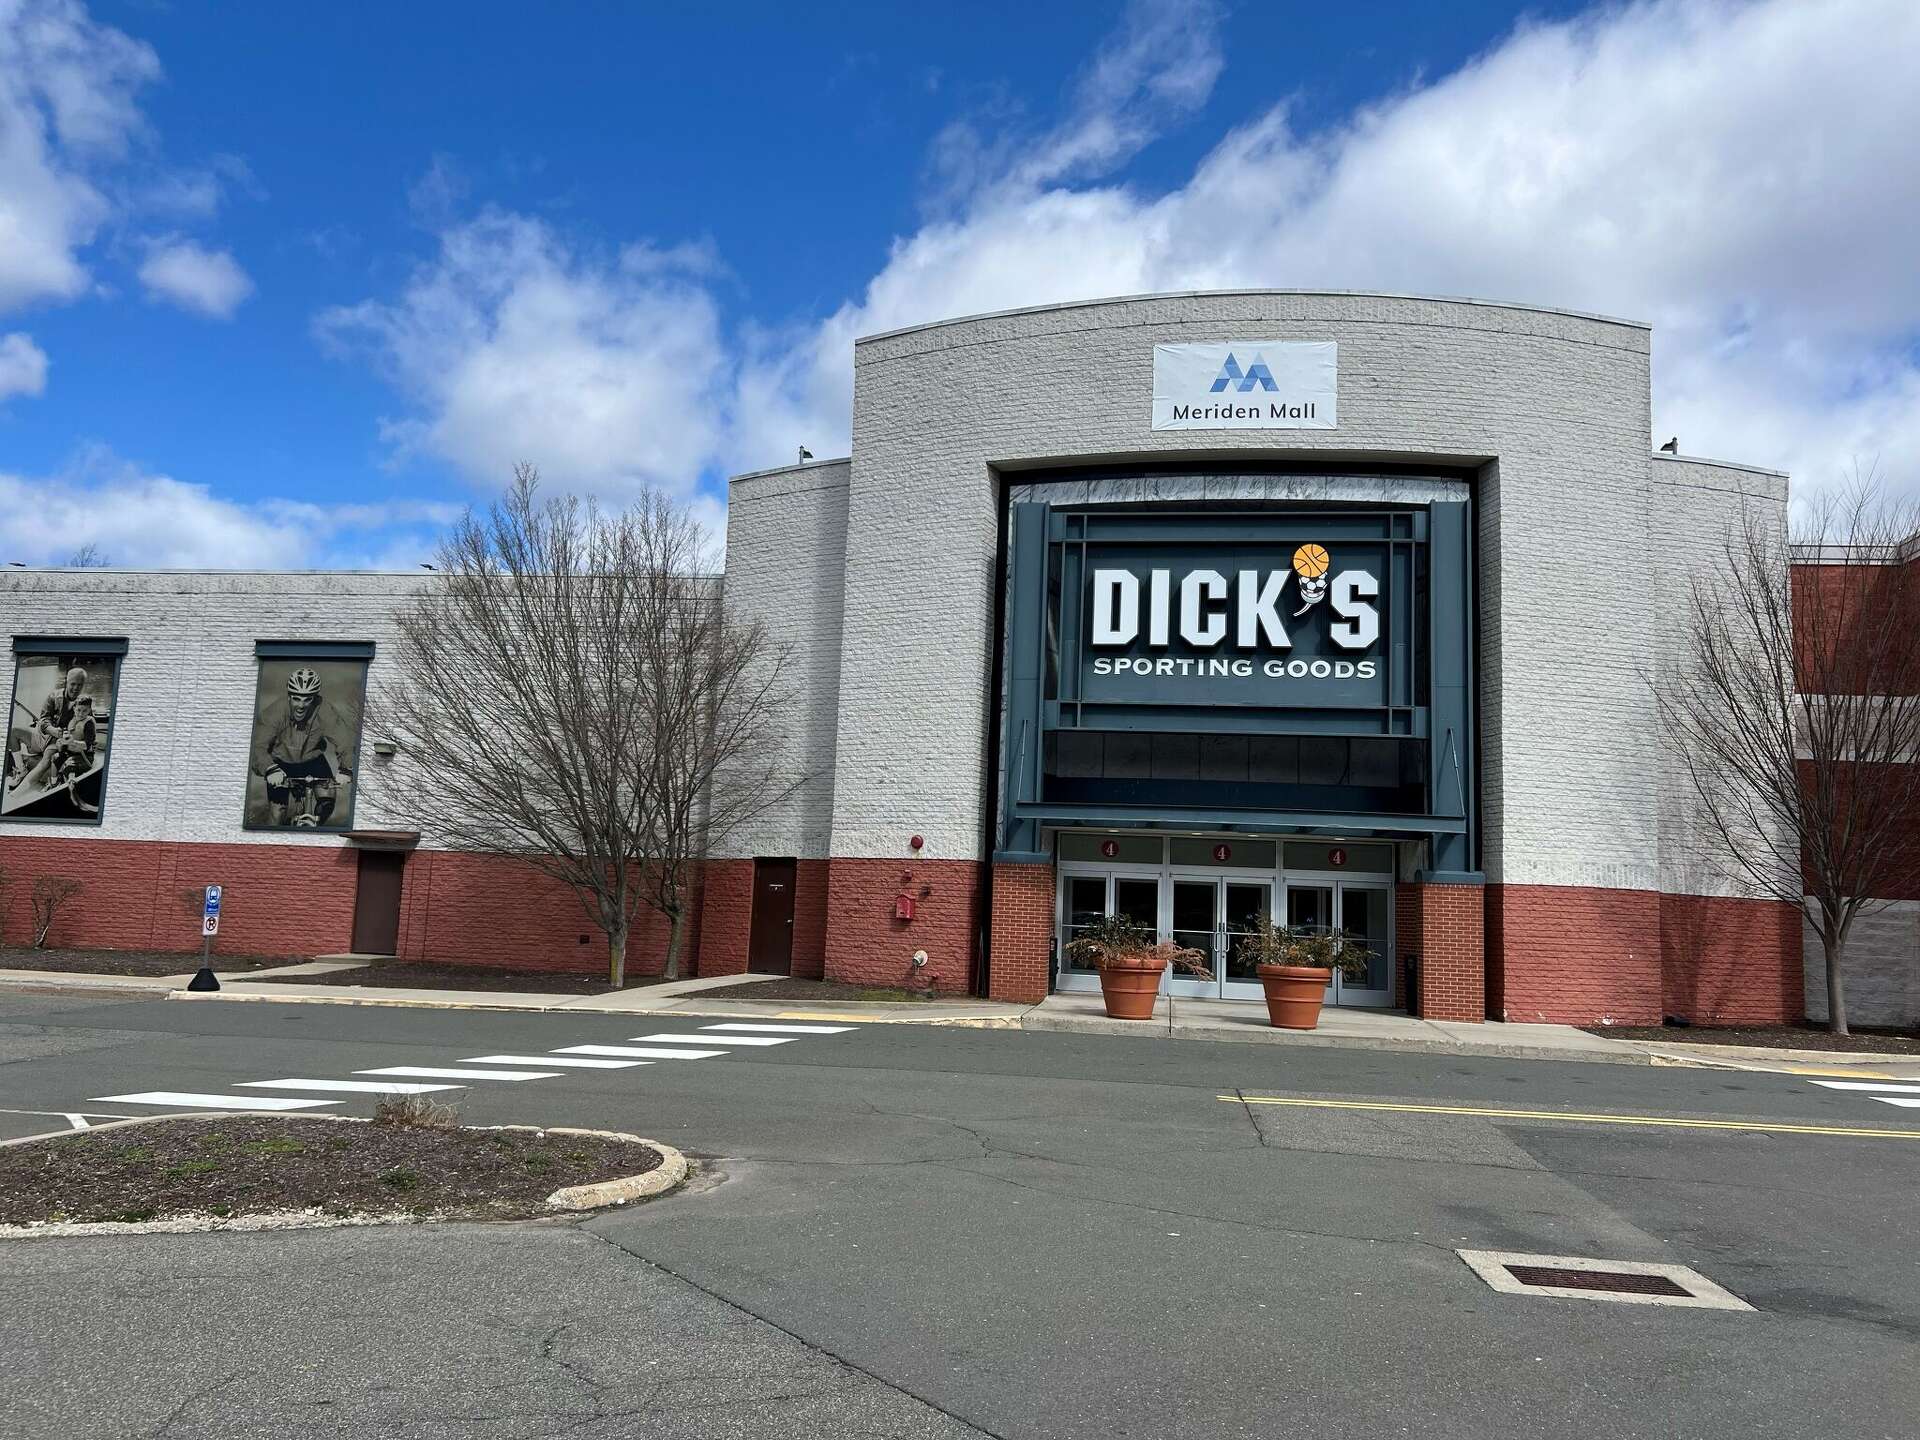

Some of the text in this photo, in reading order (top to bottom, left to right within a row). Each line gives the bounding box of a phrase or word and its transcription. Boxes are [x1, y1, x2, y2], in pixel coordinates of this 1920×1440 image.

[1173, 403, 1315, 420] Meriden Mall
[1092, 543, 1380, 649] DICK'S
[1093, 657, 1377, 680] SPORTING GOODS
